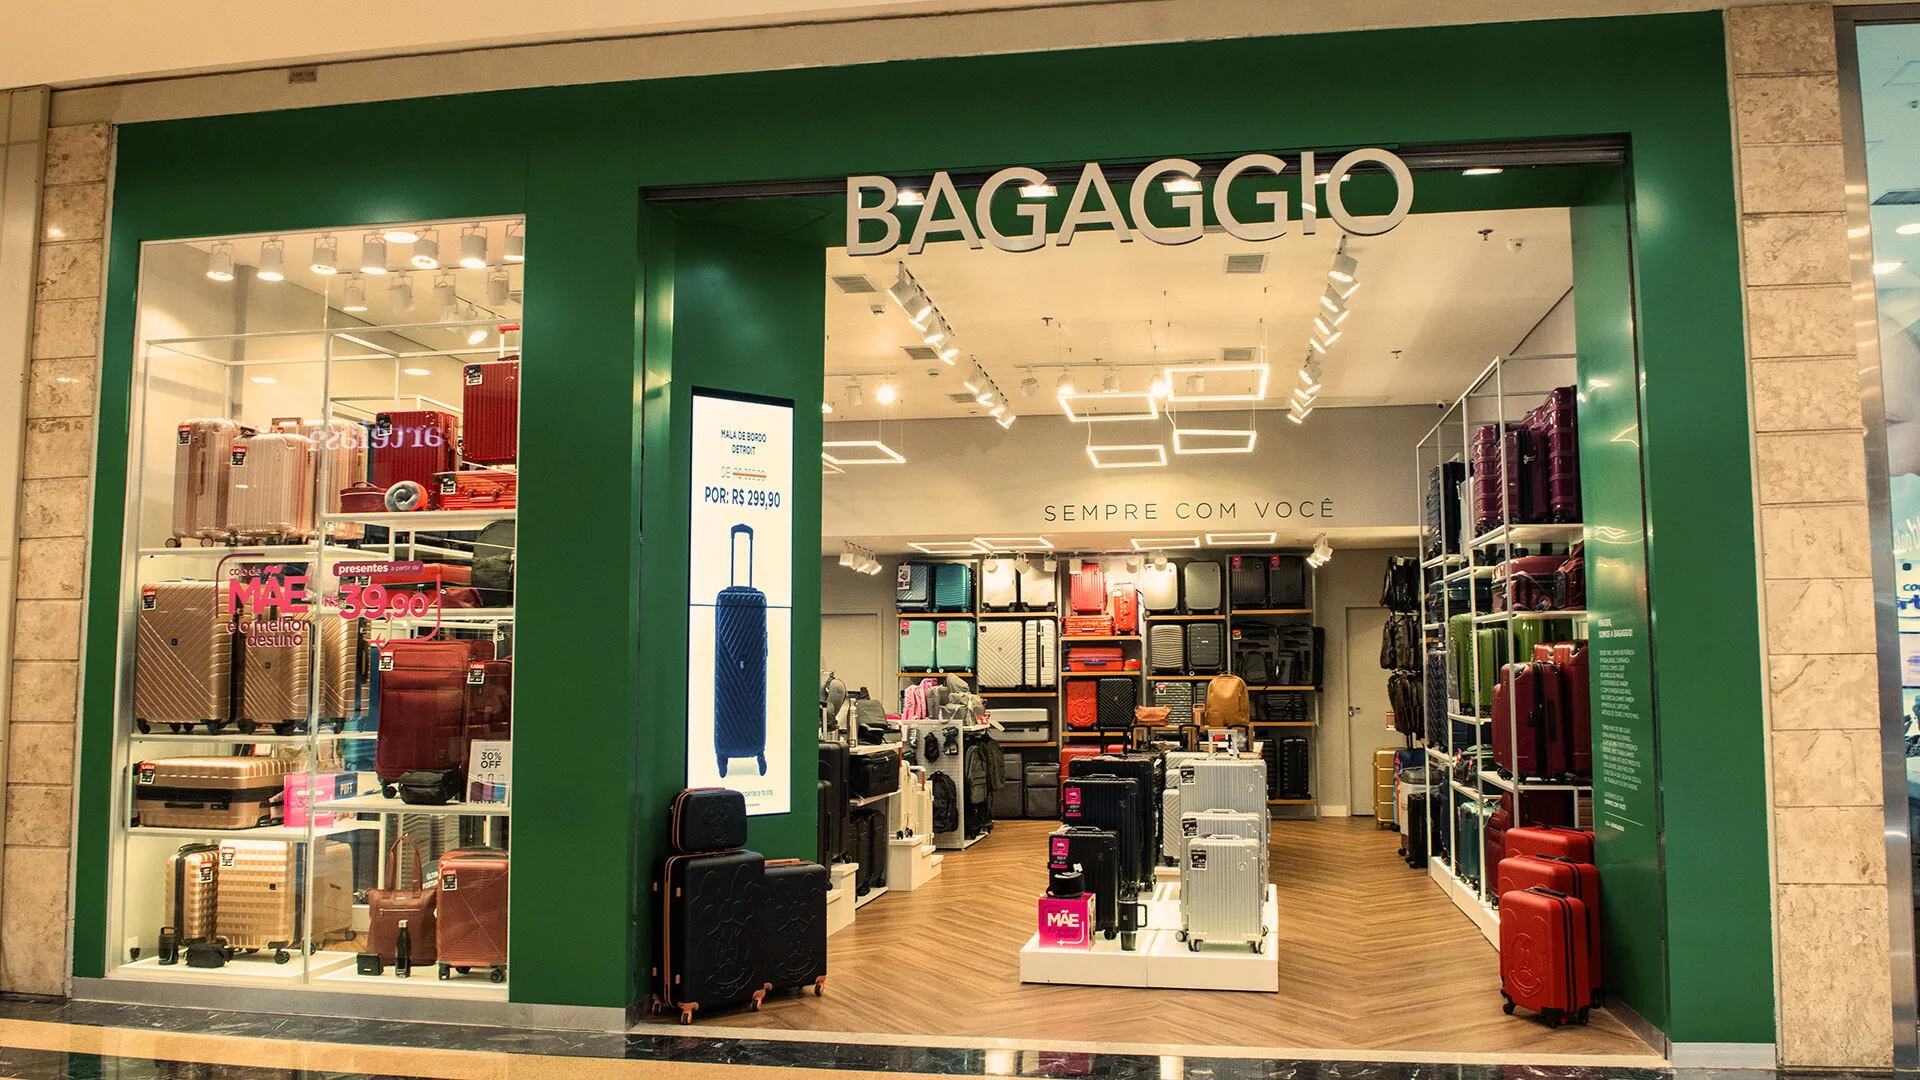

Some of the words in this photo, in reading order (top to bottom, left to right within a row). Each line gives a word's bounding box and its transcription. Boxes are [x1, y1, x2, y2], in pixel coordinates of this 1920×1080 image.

[846, 148, 1415, 257] BAGAGGIO
[721, 429, 737, 440] MALA
[738, 431, 746, 441] DE
[747, 432, 767, 442] BORDO
[732, 444, 756, 455] DETROIT
[705, 486, 729, 505] POR:
[732, 488, 745, 507] R$
[747, 489, 781, 510] 299,90
[1044, 503, 1158, 522] SEMPRE
[1175, 502, 1237, 519] COM
[1254, 497, 1334, 518] VOCÊ
[338, 563, 389, 575] presentes
[395, 564, 411, 572] partir
[227, 565, 310, 615] MÃE
[323, 595, 340, 608] R$
[339, 583, 429, 623] 39,90
[239, 621, 250, 634] o
[252, 616, 309, 635] melhor
[246, 632, 303, 648] destino
[480, 760, 502, 769] OFF
[481, 751, 503, 761] 30%
[340, 781, 354, 795] PUFF
[1047, 909, 1080, 928] MÃE
